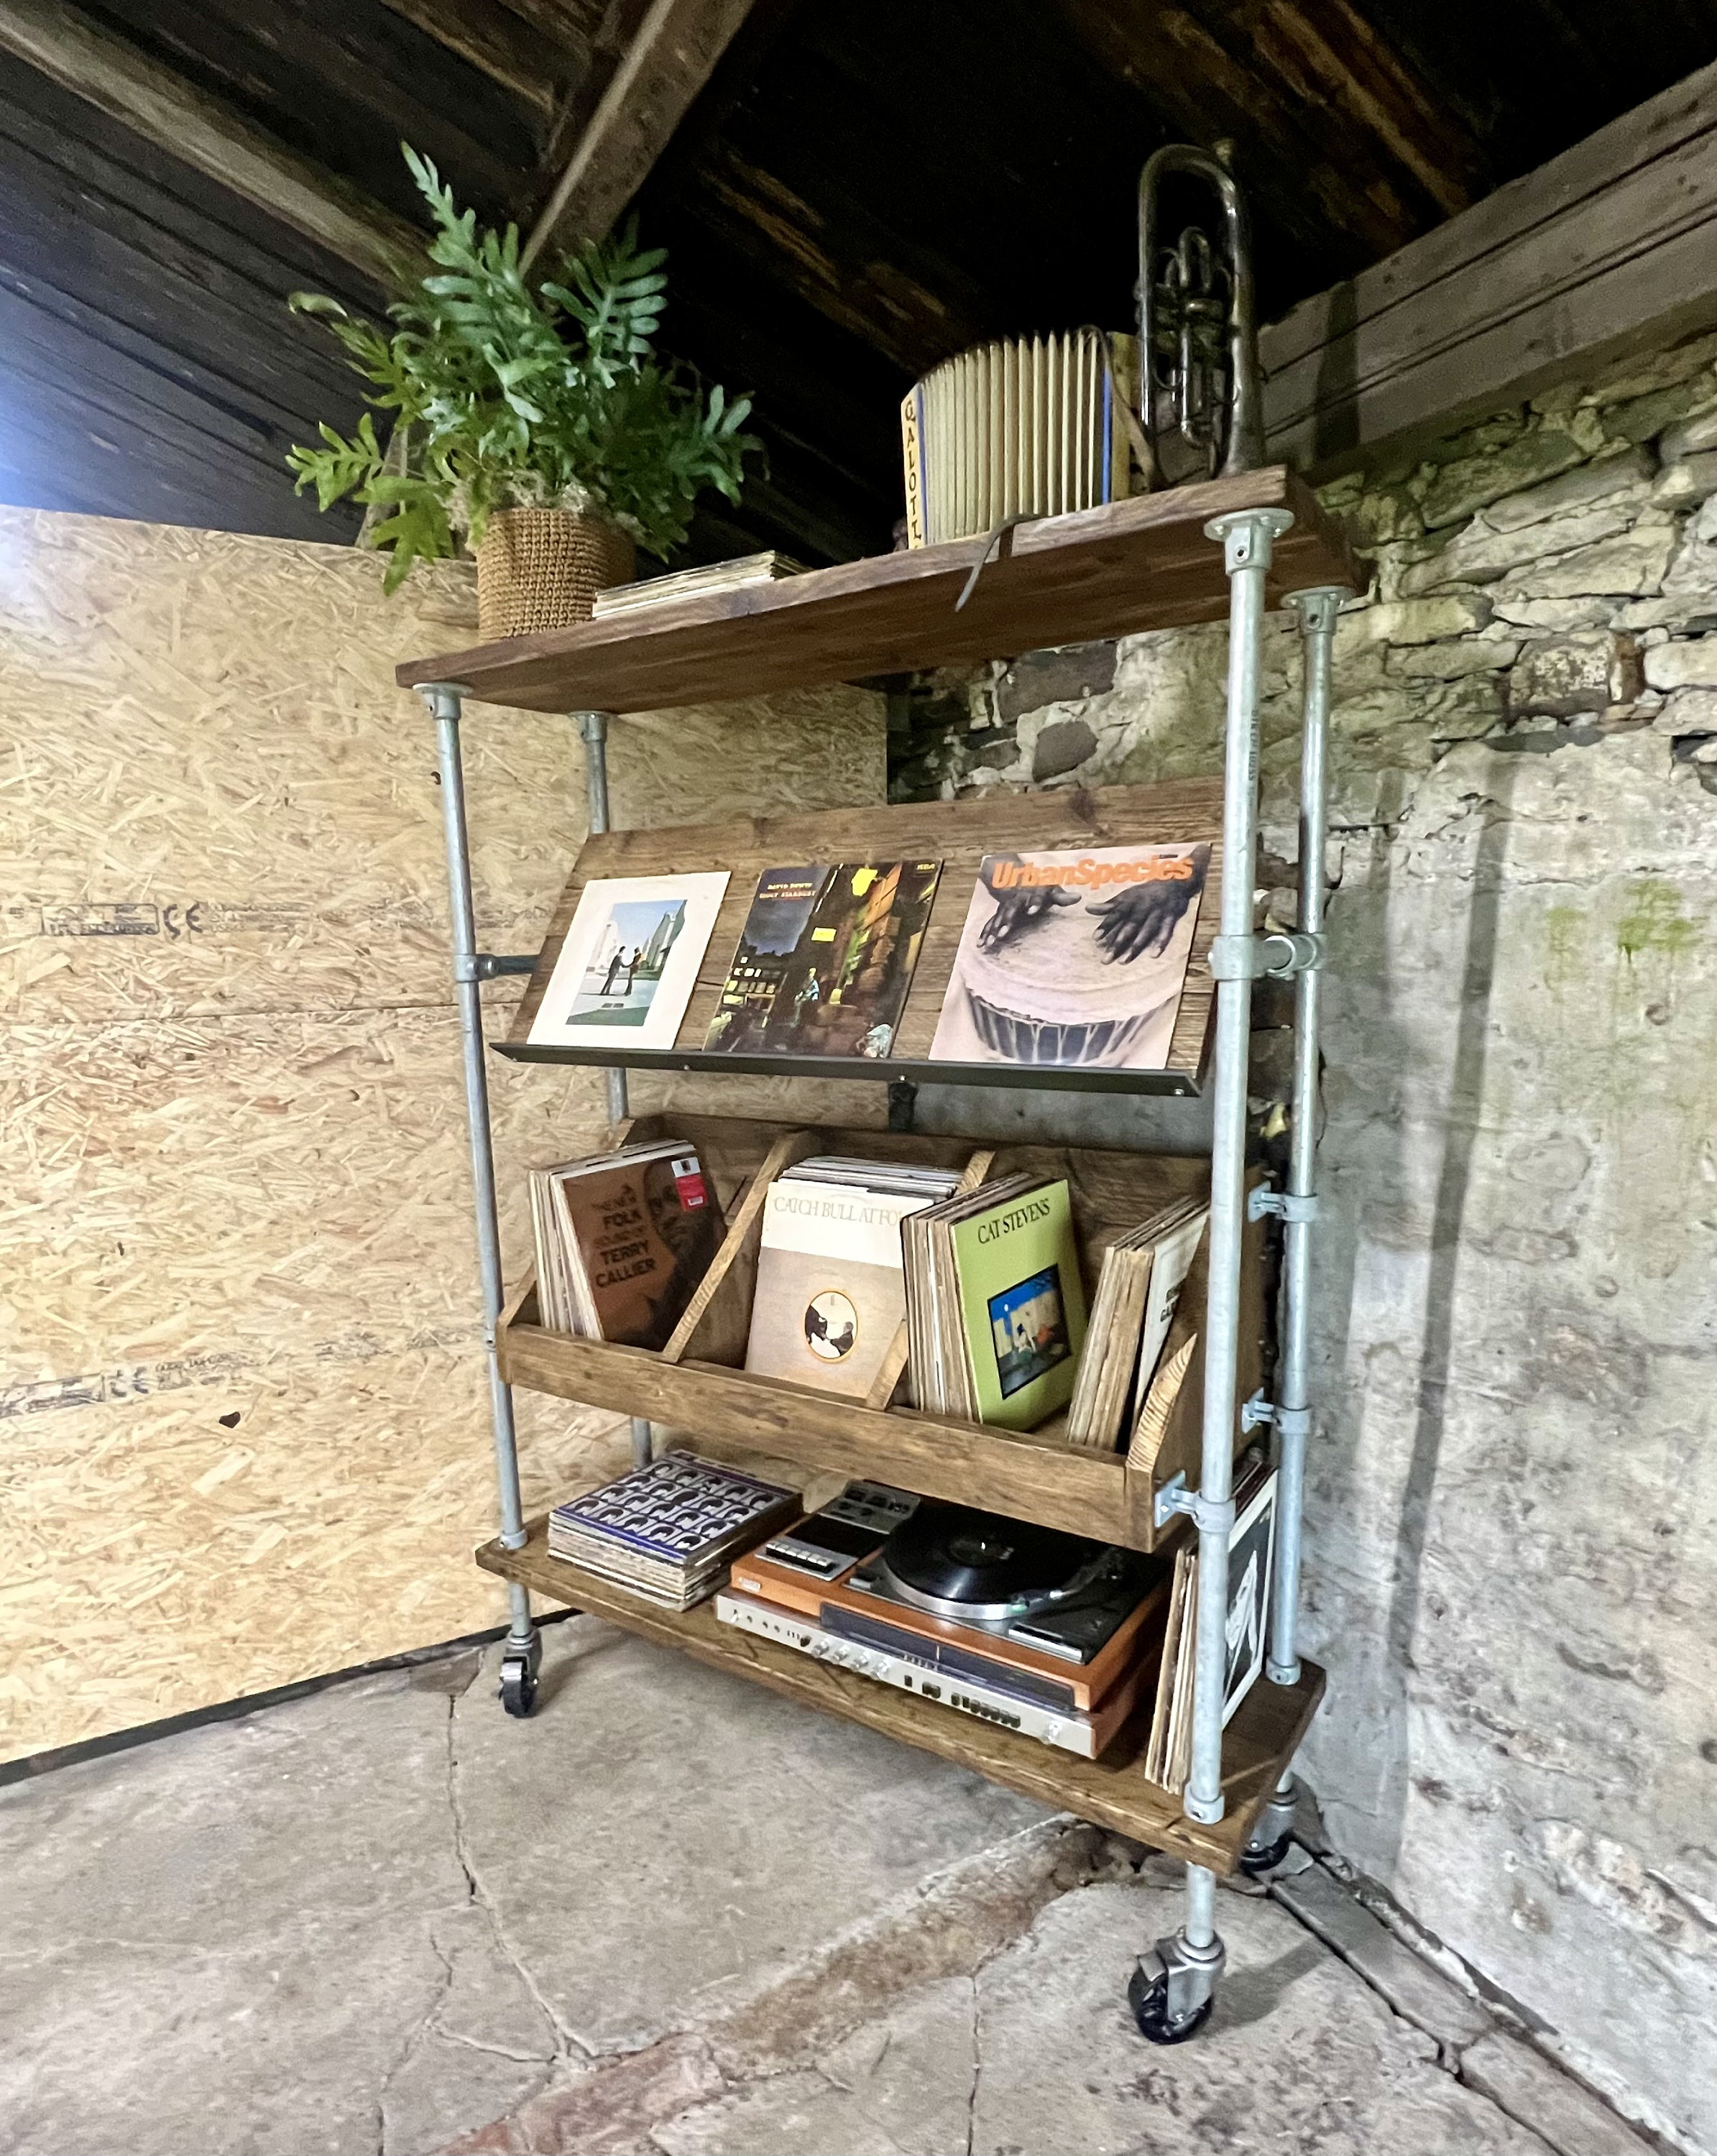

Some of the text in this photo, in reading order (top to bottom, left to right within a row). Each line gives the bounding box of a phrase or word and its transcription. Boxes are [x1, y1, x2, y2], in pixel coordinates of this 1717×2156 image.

[774, 1196, 819, 1217] CATCH
[821, 1202, 857, 1221] BULL
[878, 1210, 903, 1227] FO
[978, 1198, 1050, 1244] CAT STEVENS
[596, 1258, 657, 1289] CALLIER
